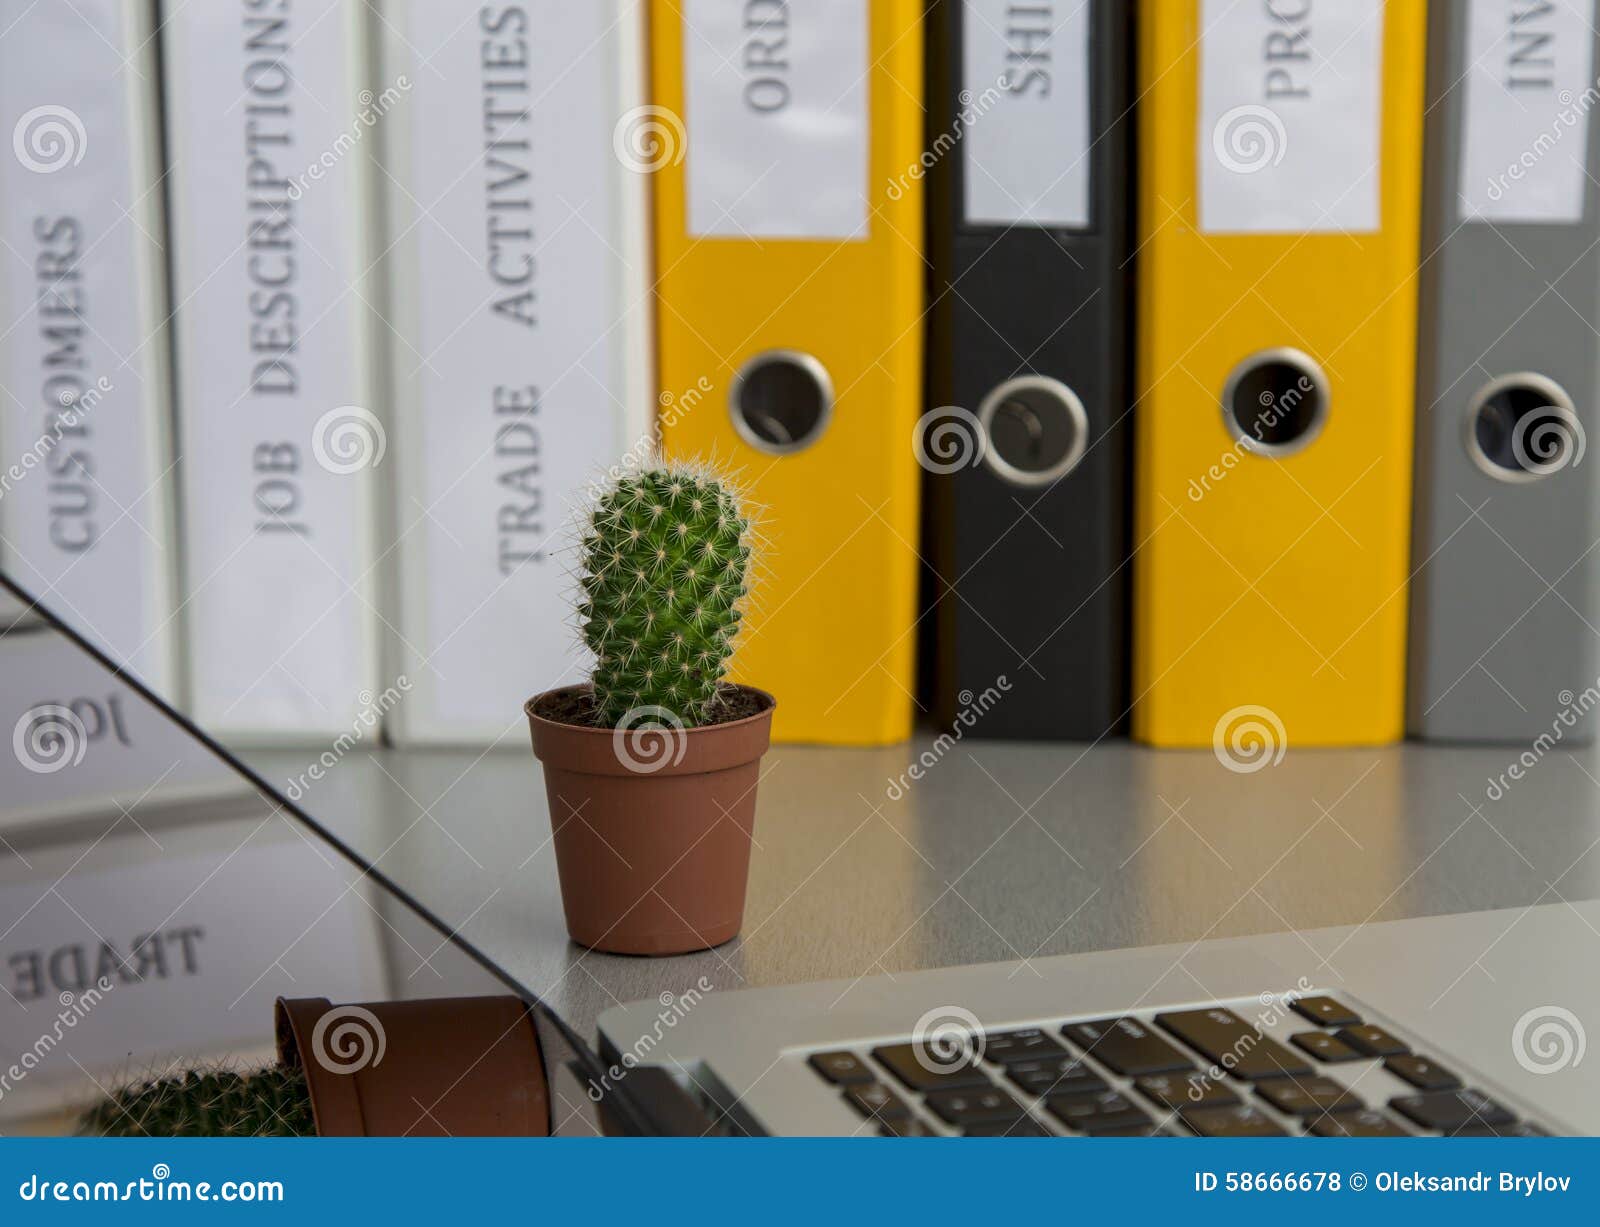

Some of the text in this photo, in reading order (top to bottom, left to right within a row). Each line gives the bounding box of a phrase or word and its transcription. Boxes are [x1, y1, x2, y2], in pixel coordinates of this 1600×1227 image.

[742, 0, 792, 115] ORD
[1004, 5, 1053, 100] SHI
[480, 5, 545, 576] TRADE ACTIVITIES
[34, 215, 97, 554] CUSTOMERS
[253, 441, 309, 536] JOB
